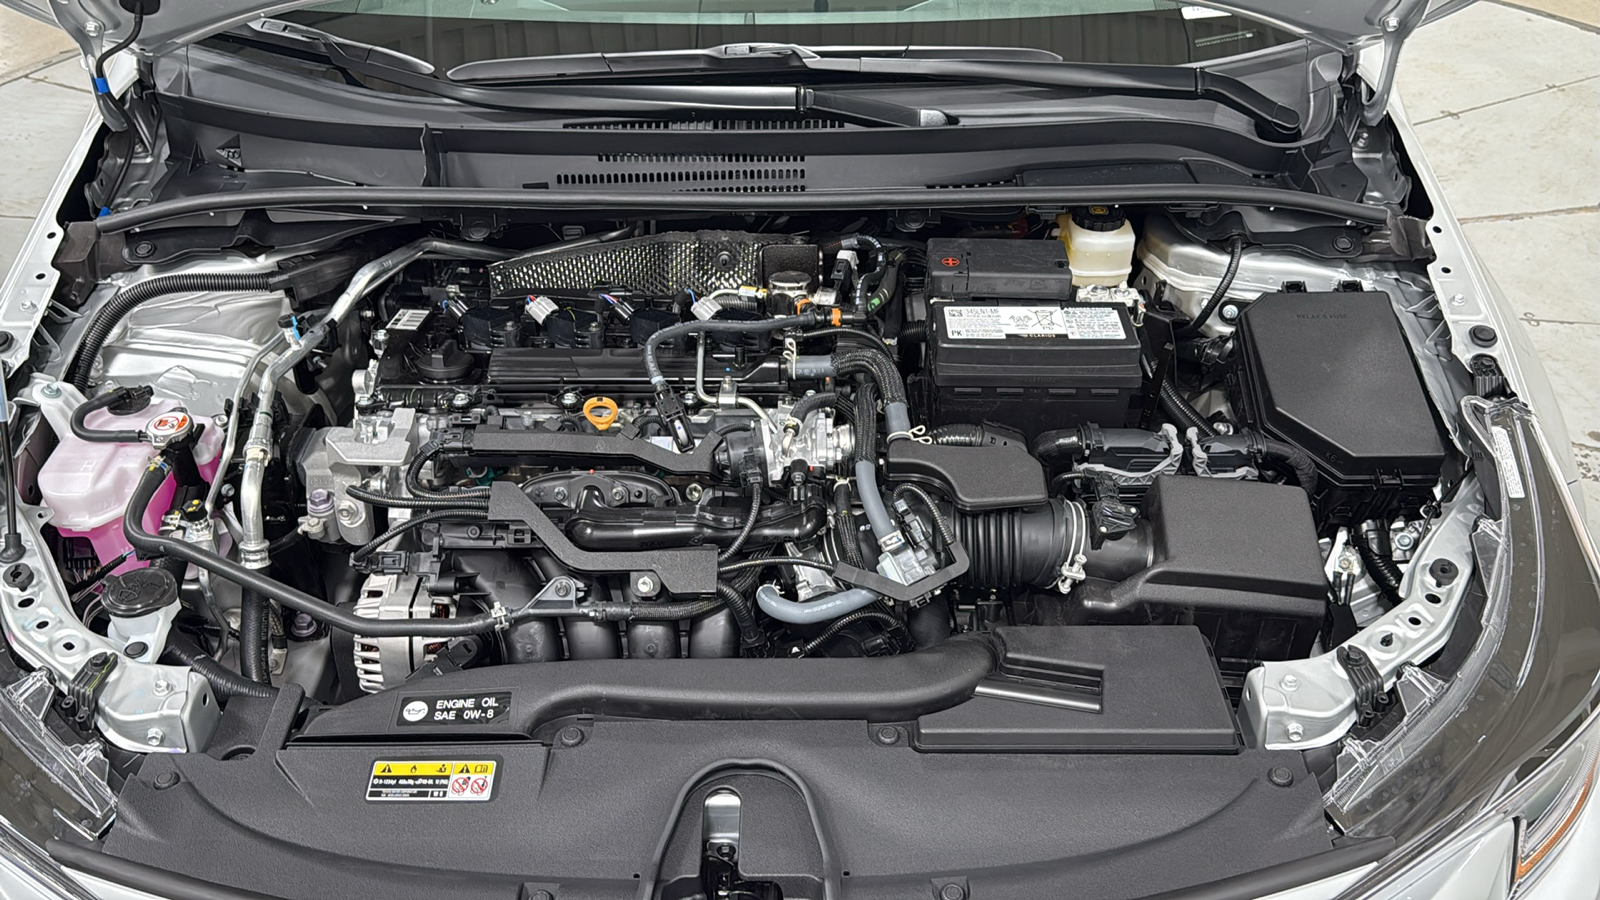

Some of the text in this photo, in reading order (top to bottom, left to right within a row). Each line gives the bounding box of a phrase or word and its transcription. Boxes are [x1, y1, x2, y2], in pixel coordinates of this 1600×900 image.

[435, 697, 499, 710] ENGINE OIL
[433, 709, 494, 721] SAE 0W-8
